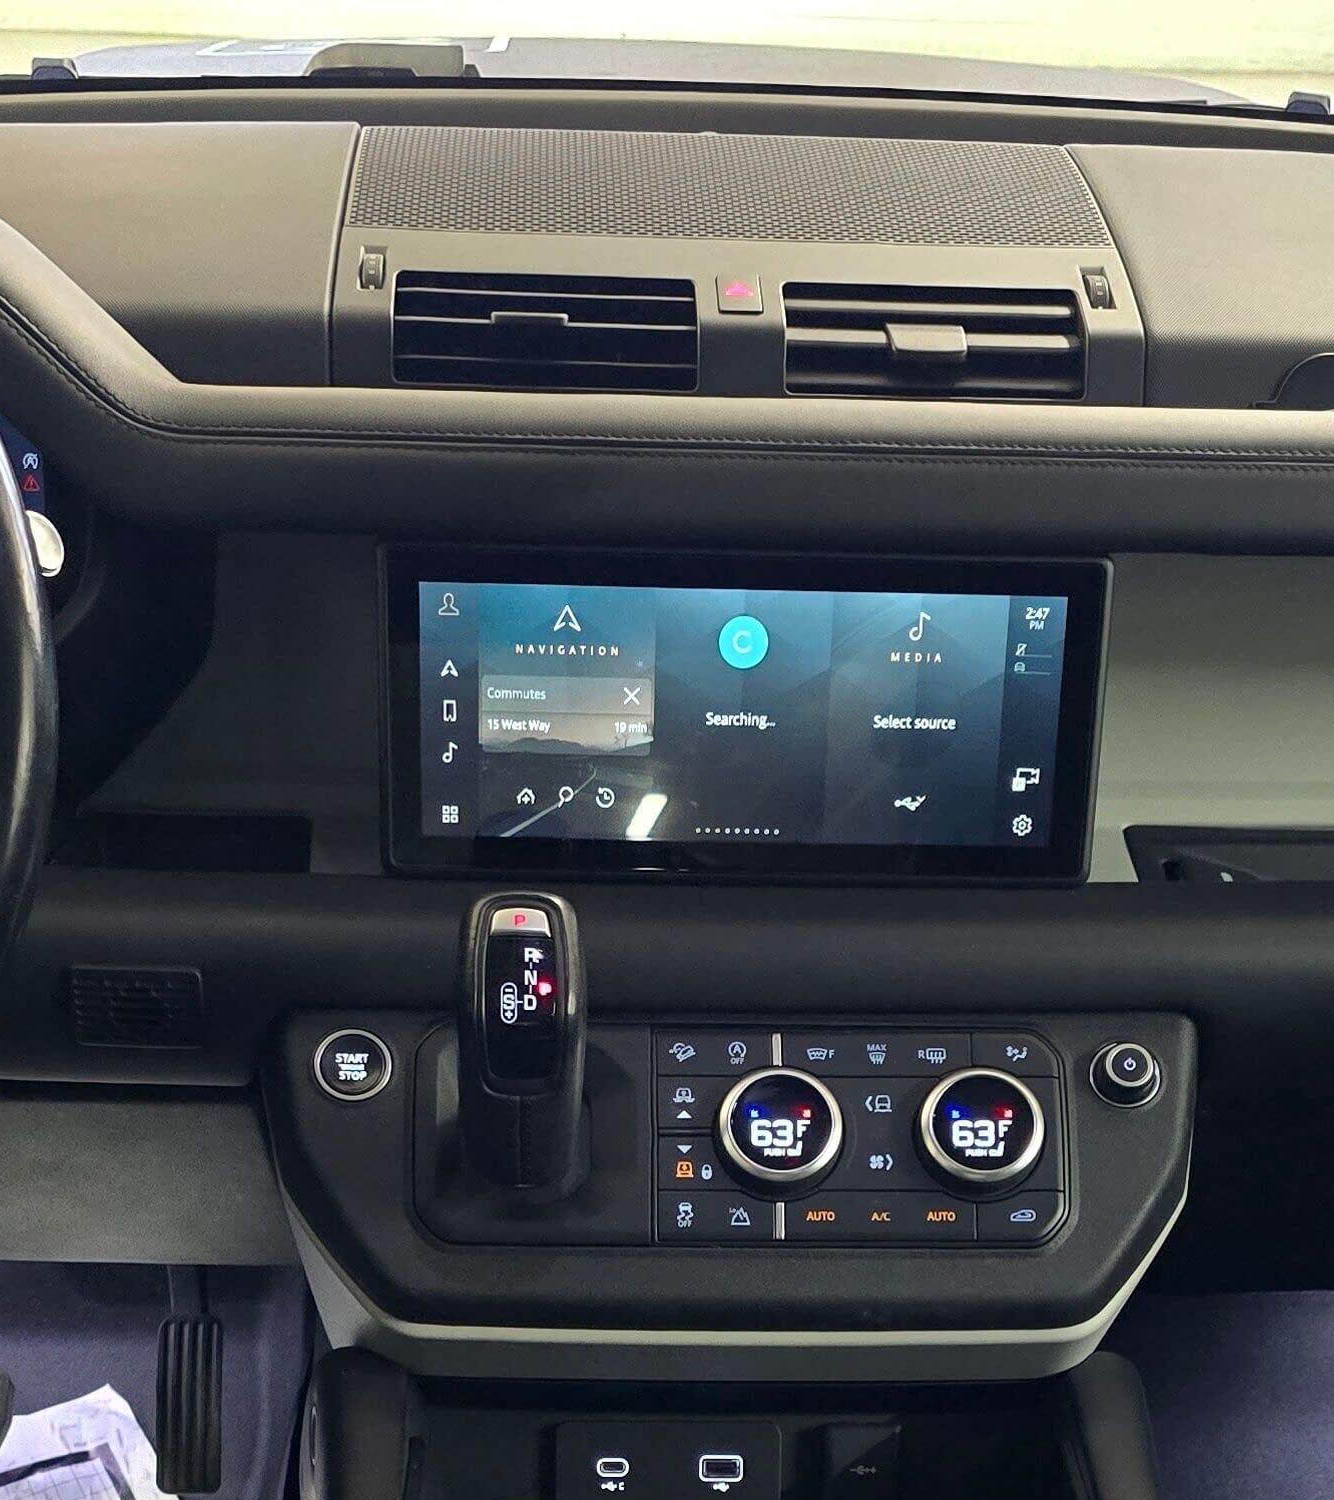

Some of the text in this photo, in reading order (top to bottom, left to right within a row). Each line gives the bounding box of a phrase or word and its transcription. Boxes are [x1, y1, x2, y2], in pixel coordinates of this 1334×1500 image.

[1025, 607, 1050, 621] 2:47
[1029, 620, 1045, 630] PM
[515, 644, 619, 656] NAVIGATION
[890, 652, 942, 663] MEDIA
[487, 687, 547, 700] Commutes
[487, 719, 499, 730] 15
[528, 720, 551, 734] Way
[873, 714, 957, 730] Select source
[514, 914, 526, 926] P
[524, 970, 537, 985] N
[523, 995, 537, 1011] D
[335, 1053, 369, 1064] START
[918, 1050, 925, 1059] R
[730, 1057, 744, 1065] OFF
[338, 1071, 367, 1081] STOP
[806, 1211, 835, 1221] AUTO
[871, 1212, 891, 1221] A/C
[927, 1212, 956, 1221] AUTO
[677, 1219, 692, 1228] OFF
